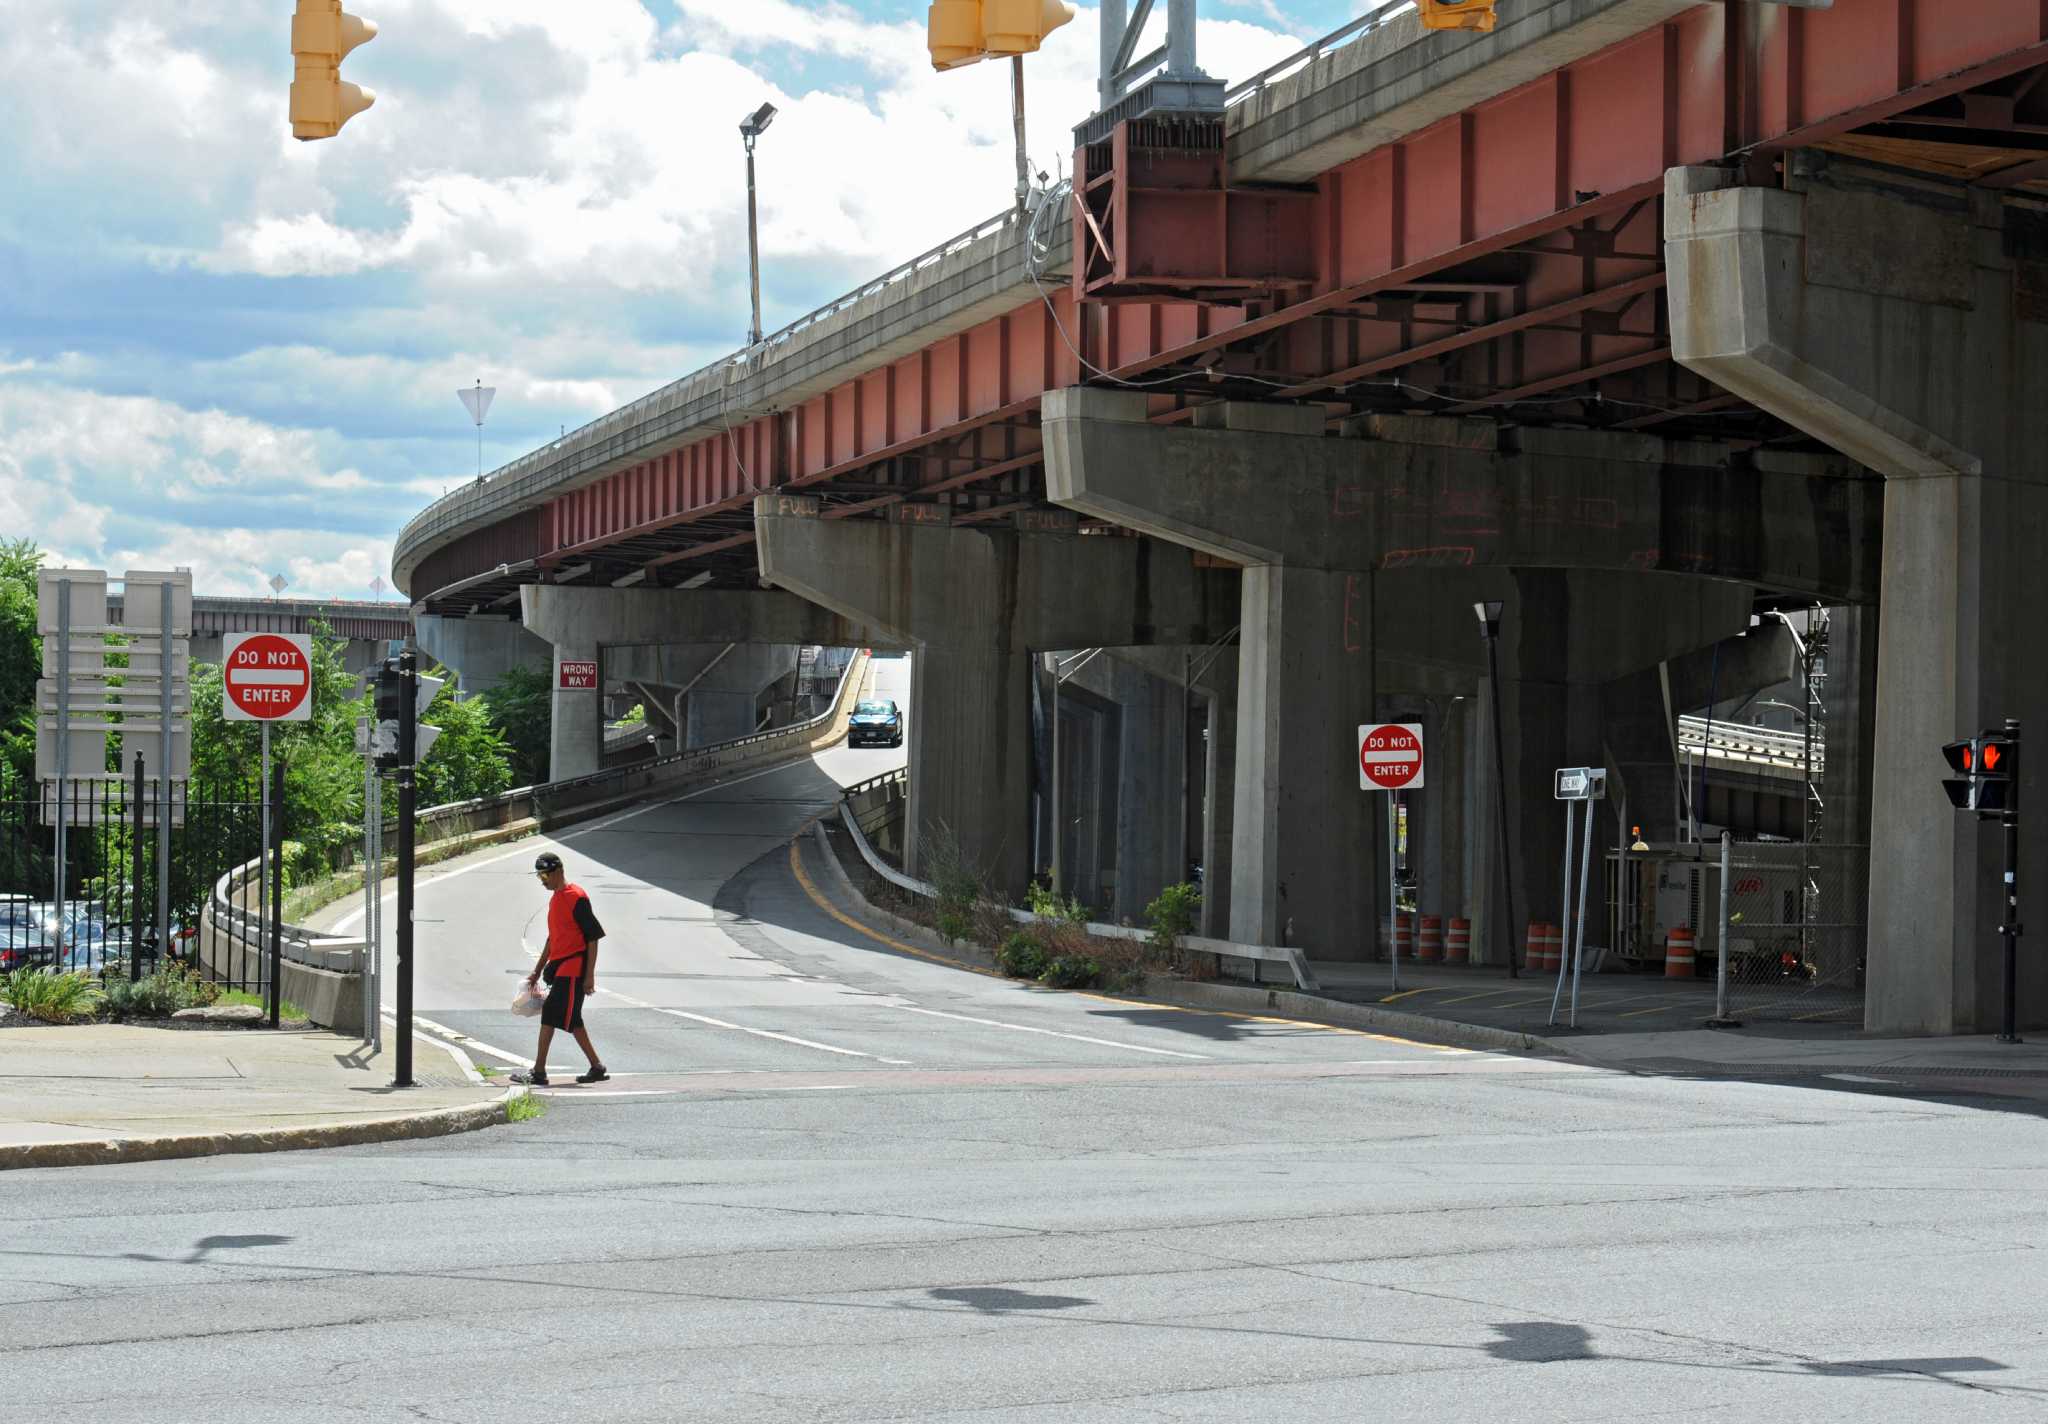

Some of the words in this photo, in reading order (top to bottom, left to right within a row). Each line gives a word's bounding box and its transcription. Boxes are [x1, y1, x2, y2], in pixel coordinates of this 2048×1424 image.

[238, 651, 259, 665] DO
[267, 651, 298, 665] NOT
[562, 664, 594, 675] WRONG
[568, 676, 588, 686] WAY
[242, 688, 291, 703] ENTER
[1369, 737, 1384, 748] DO
[1391, 736, 1413, 748] NOT
[1374, 765, 1409, 776] ENTER
